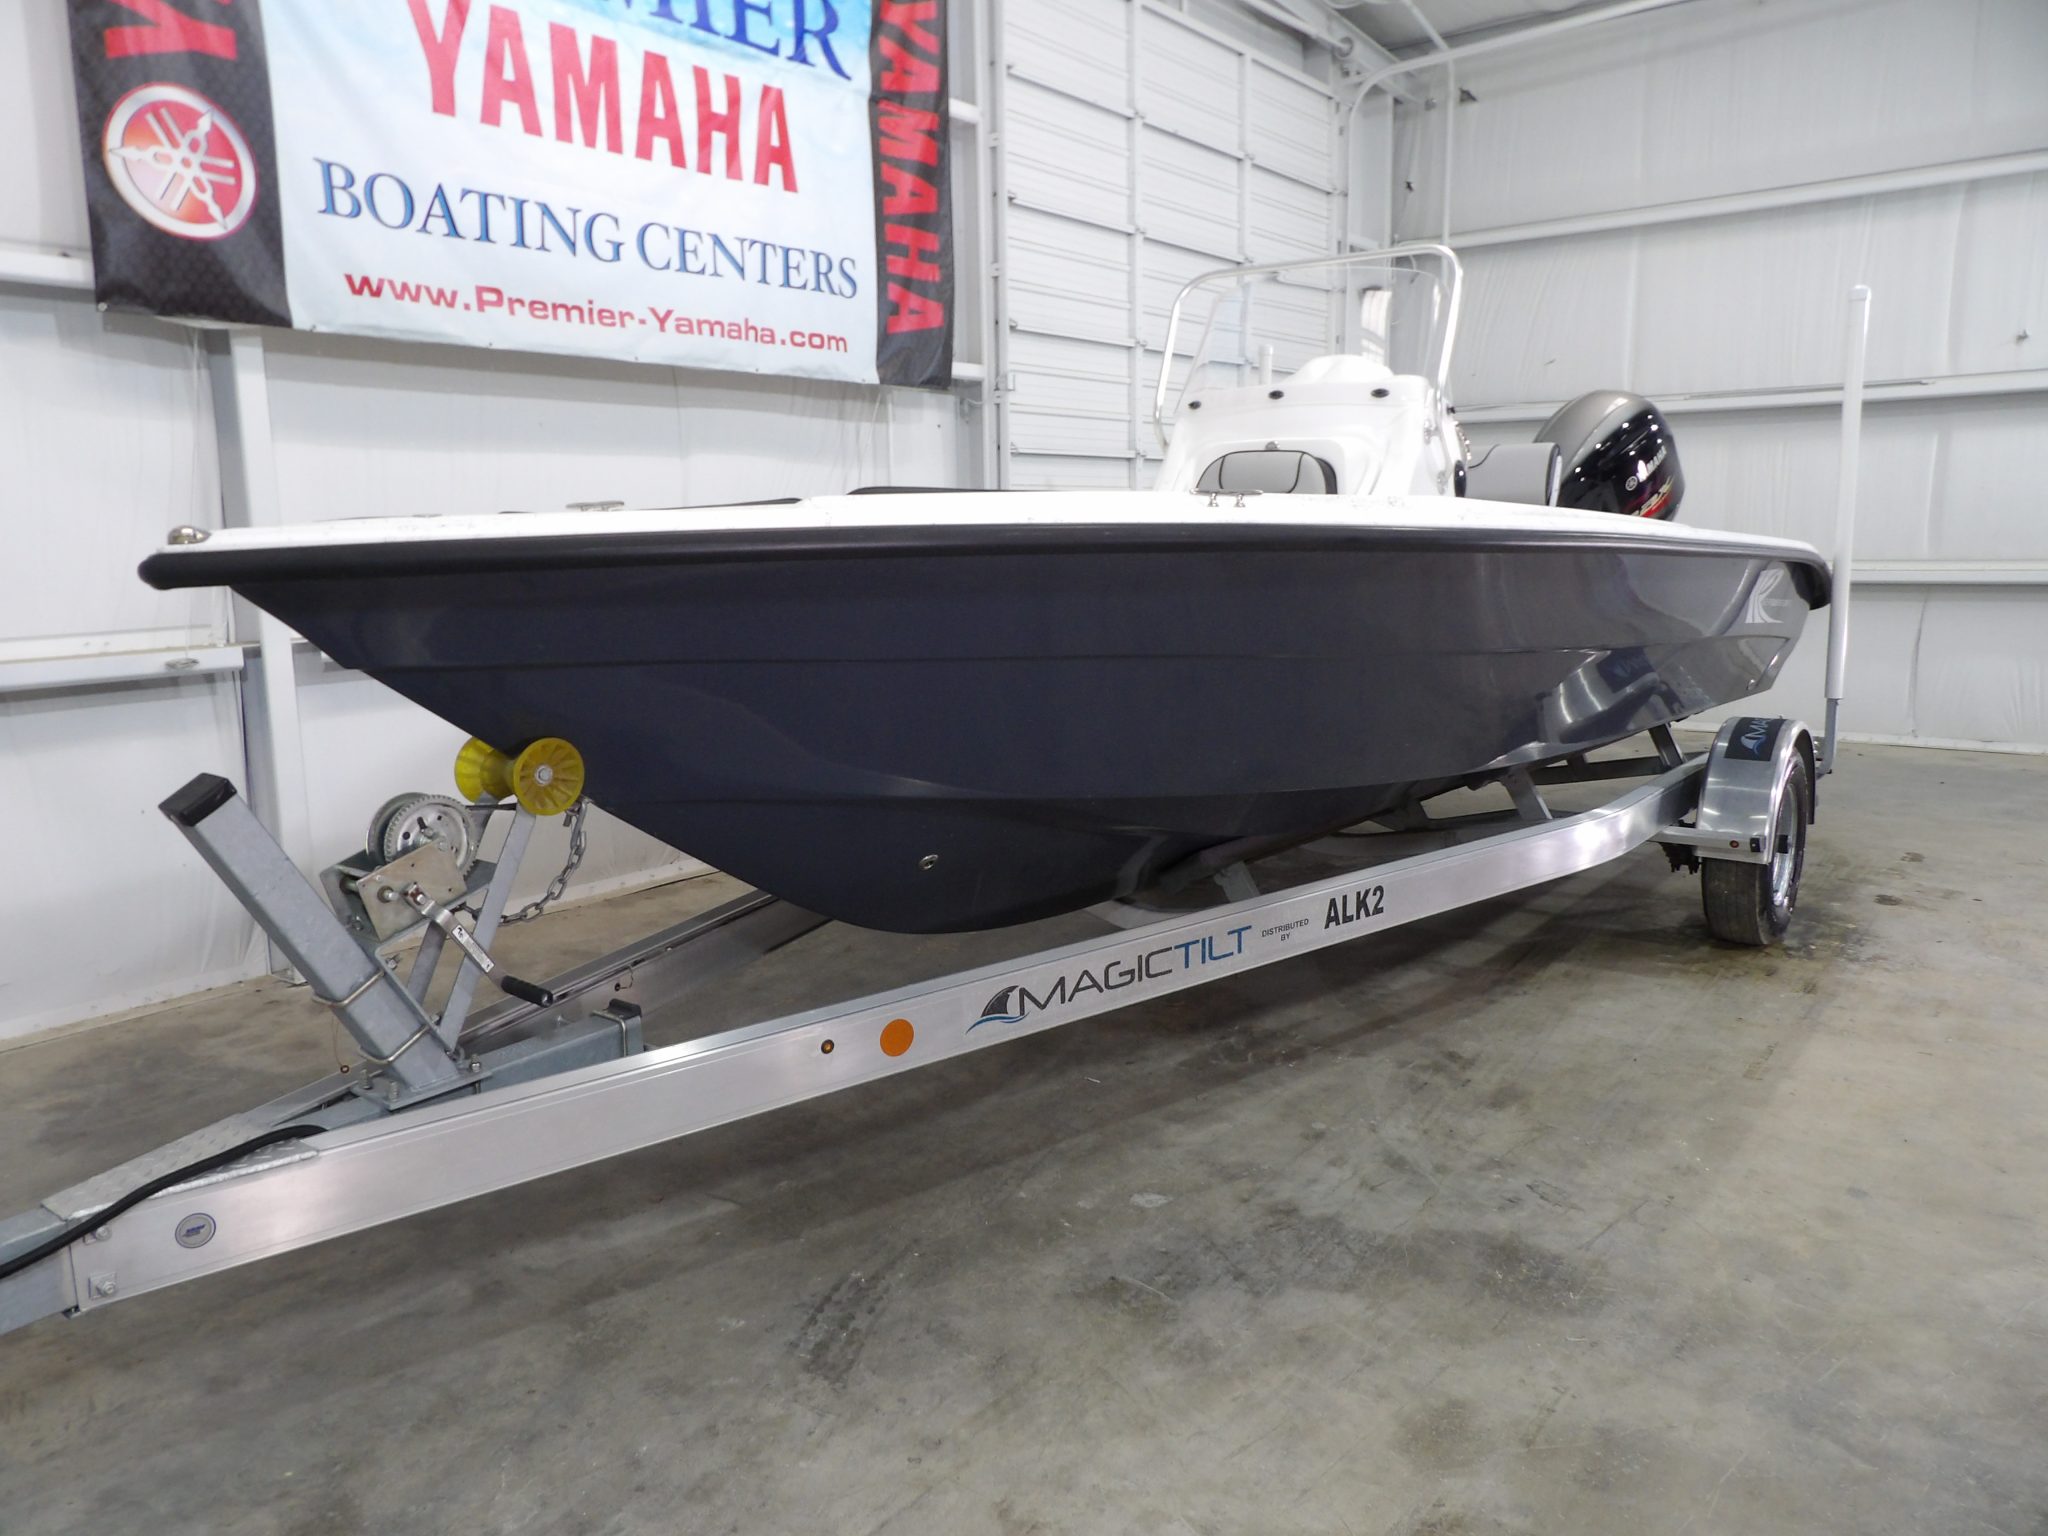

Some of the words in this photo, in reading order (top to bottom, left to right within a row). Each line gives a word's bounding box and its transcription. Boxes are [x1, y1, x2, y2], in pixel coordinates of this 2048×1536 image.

[407, 0, 799, 193] YAMAHA
[878, 0, 945, 334] YAMAHA
[313, 157, 626, 263] BOATING
[636, 222, 859, 299] CENTERS
[344, 273, 848, 353] www.Premier-Yamaha.com
[1261, 918, 1309, 938] DISTRIBUTED
[1280, 932, 1291, 942] BY
[1324, 885, 1385, 929] ALK2
